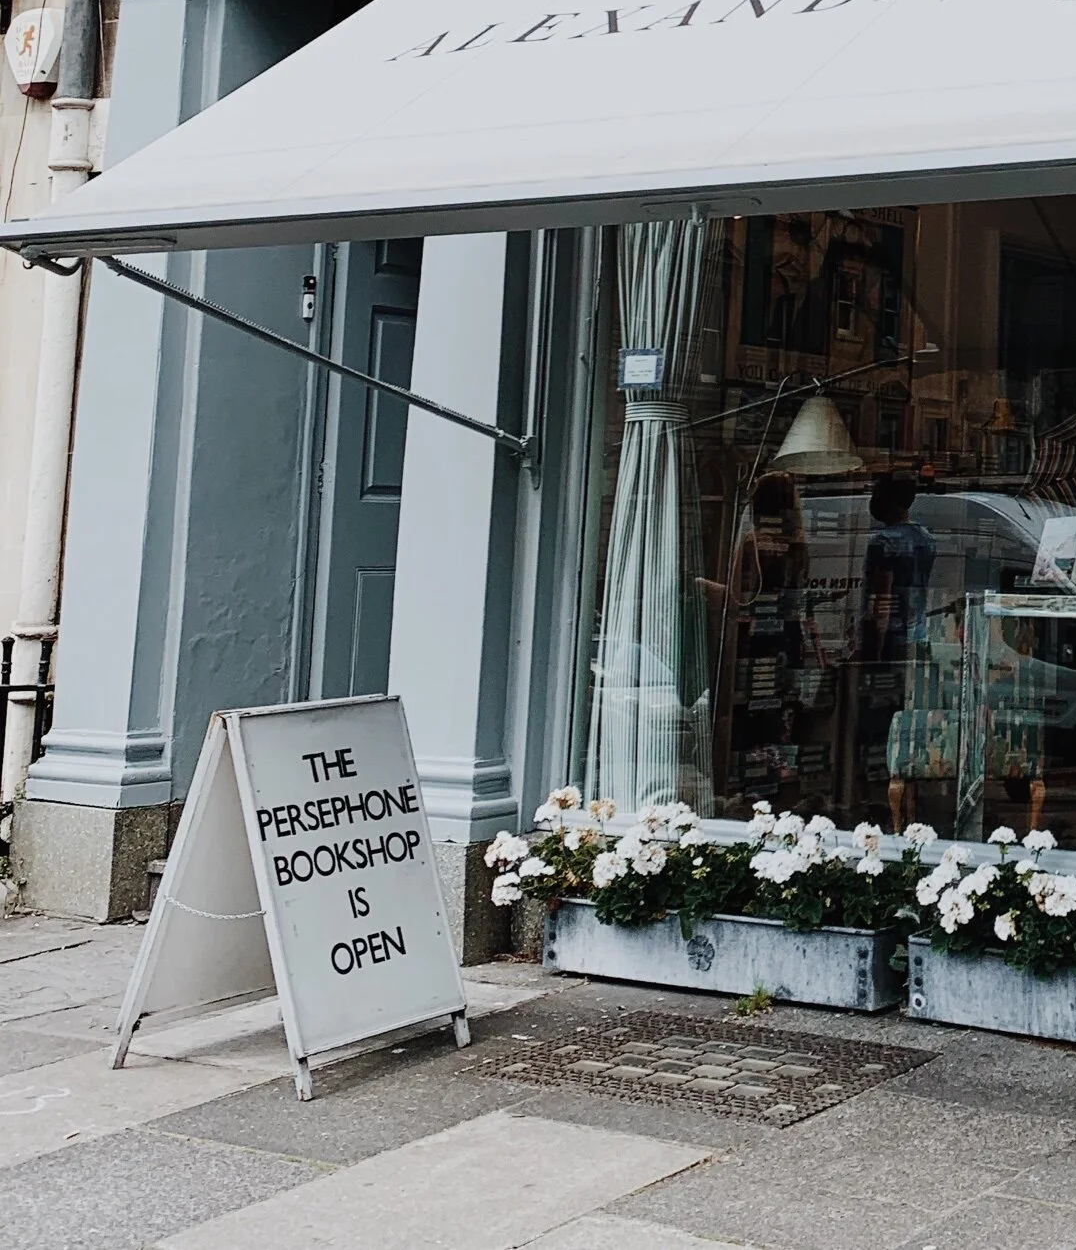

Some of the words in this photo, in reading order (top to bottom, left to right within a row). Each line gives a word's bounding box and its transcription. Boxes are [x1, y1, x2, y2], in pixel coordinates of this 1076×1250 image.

[302, 748, 357, 783] THE
[256, 784, 420, 841] PERSEPHONE
[273, 830, 420, 886] BOOKSHOP
[348, 887, 370, 918] IS
[331, 926, 407, 975] OPEN
